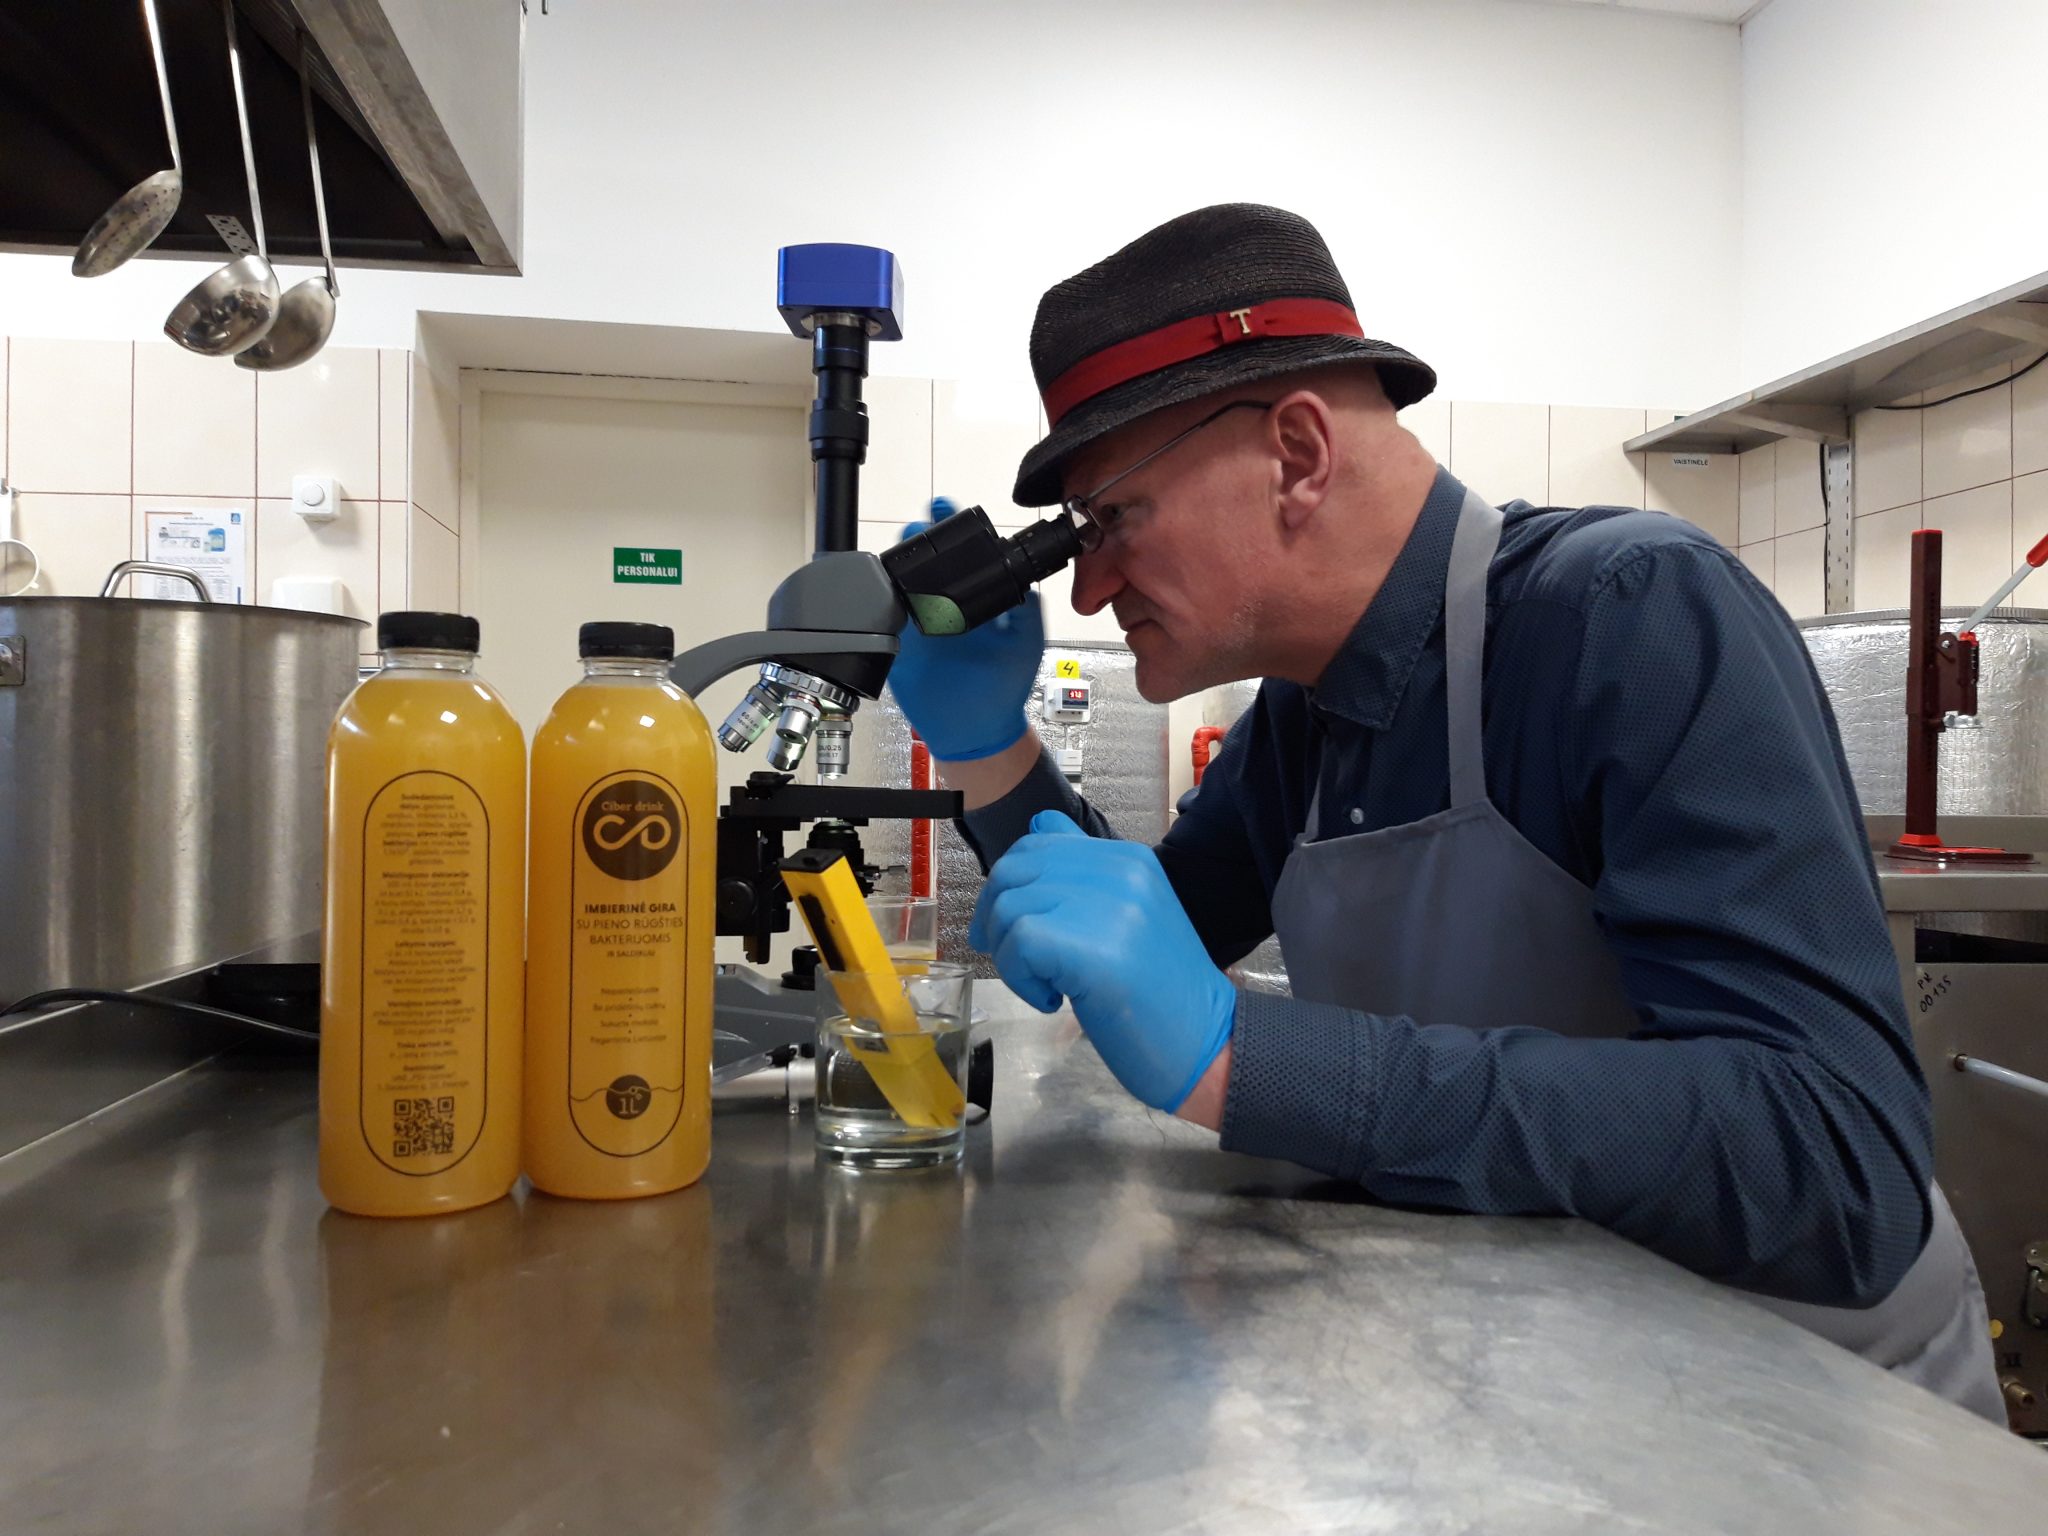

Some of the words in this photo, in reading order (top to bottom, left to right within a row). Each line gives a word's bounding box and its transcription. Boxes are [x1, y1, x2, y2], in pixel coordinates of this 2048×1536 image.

[1230, 308, 1252, 334] T
[640, 552, 655, 563] TIK
[617, 565, 678, 577] PERSONALUI
[1063, 662, 1074, 676] 4
[601, 801, 632, 812] Ciber
[635, 801, 664, 812] drink
[649, 903, 677, 913] GIRA
[576, 919, 591, 929] SU
[593, 919, 631, 929] PIENO
